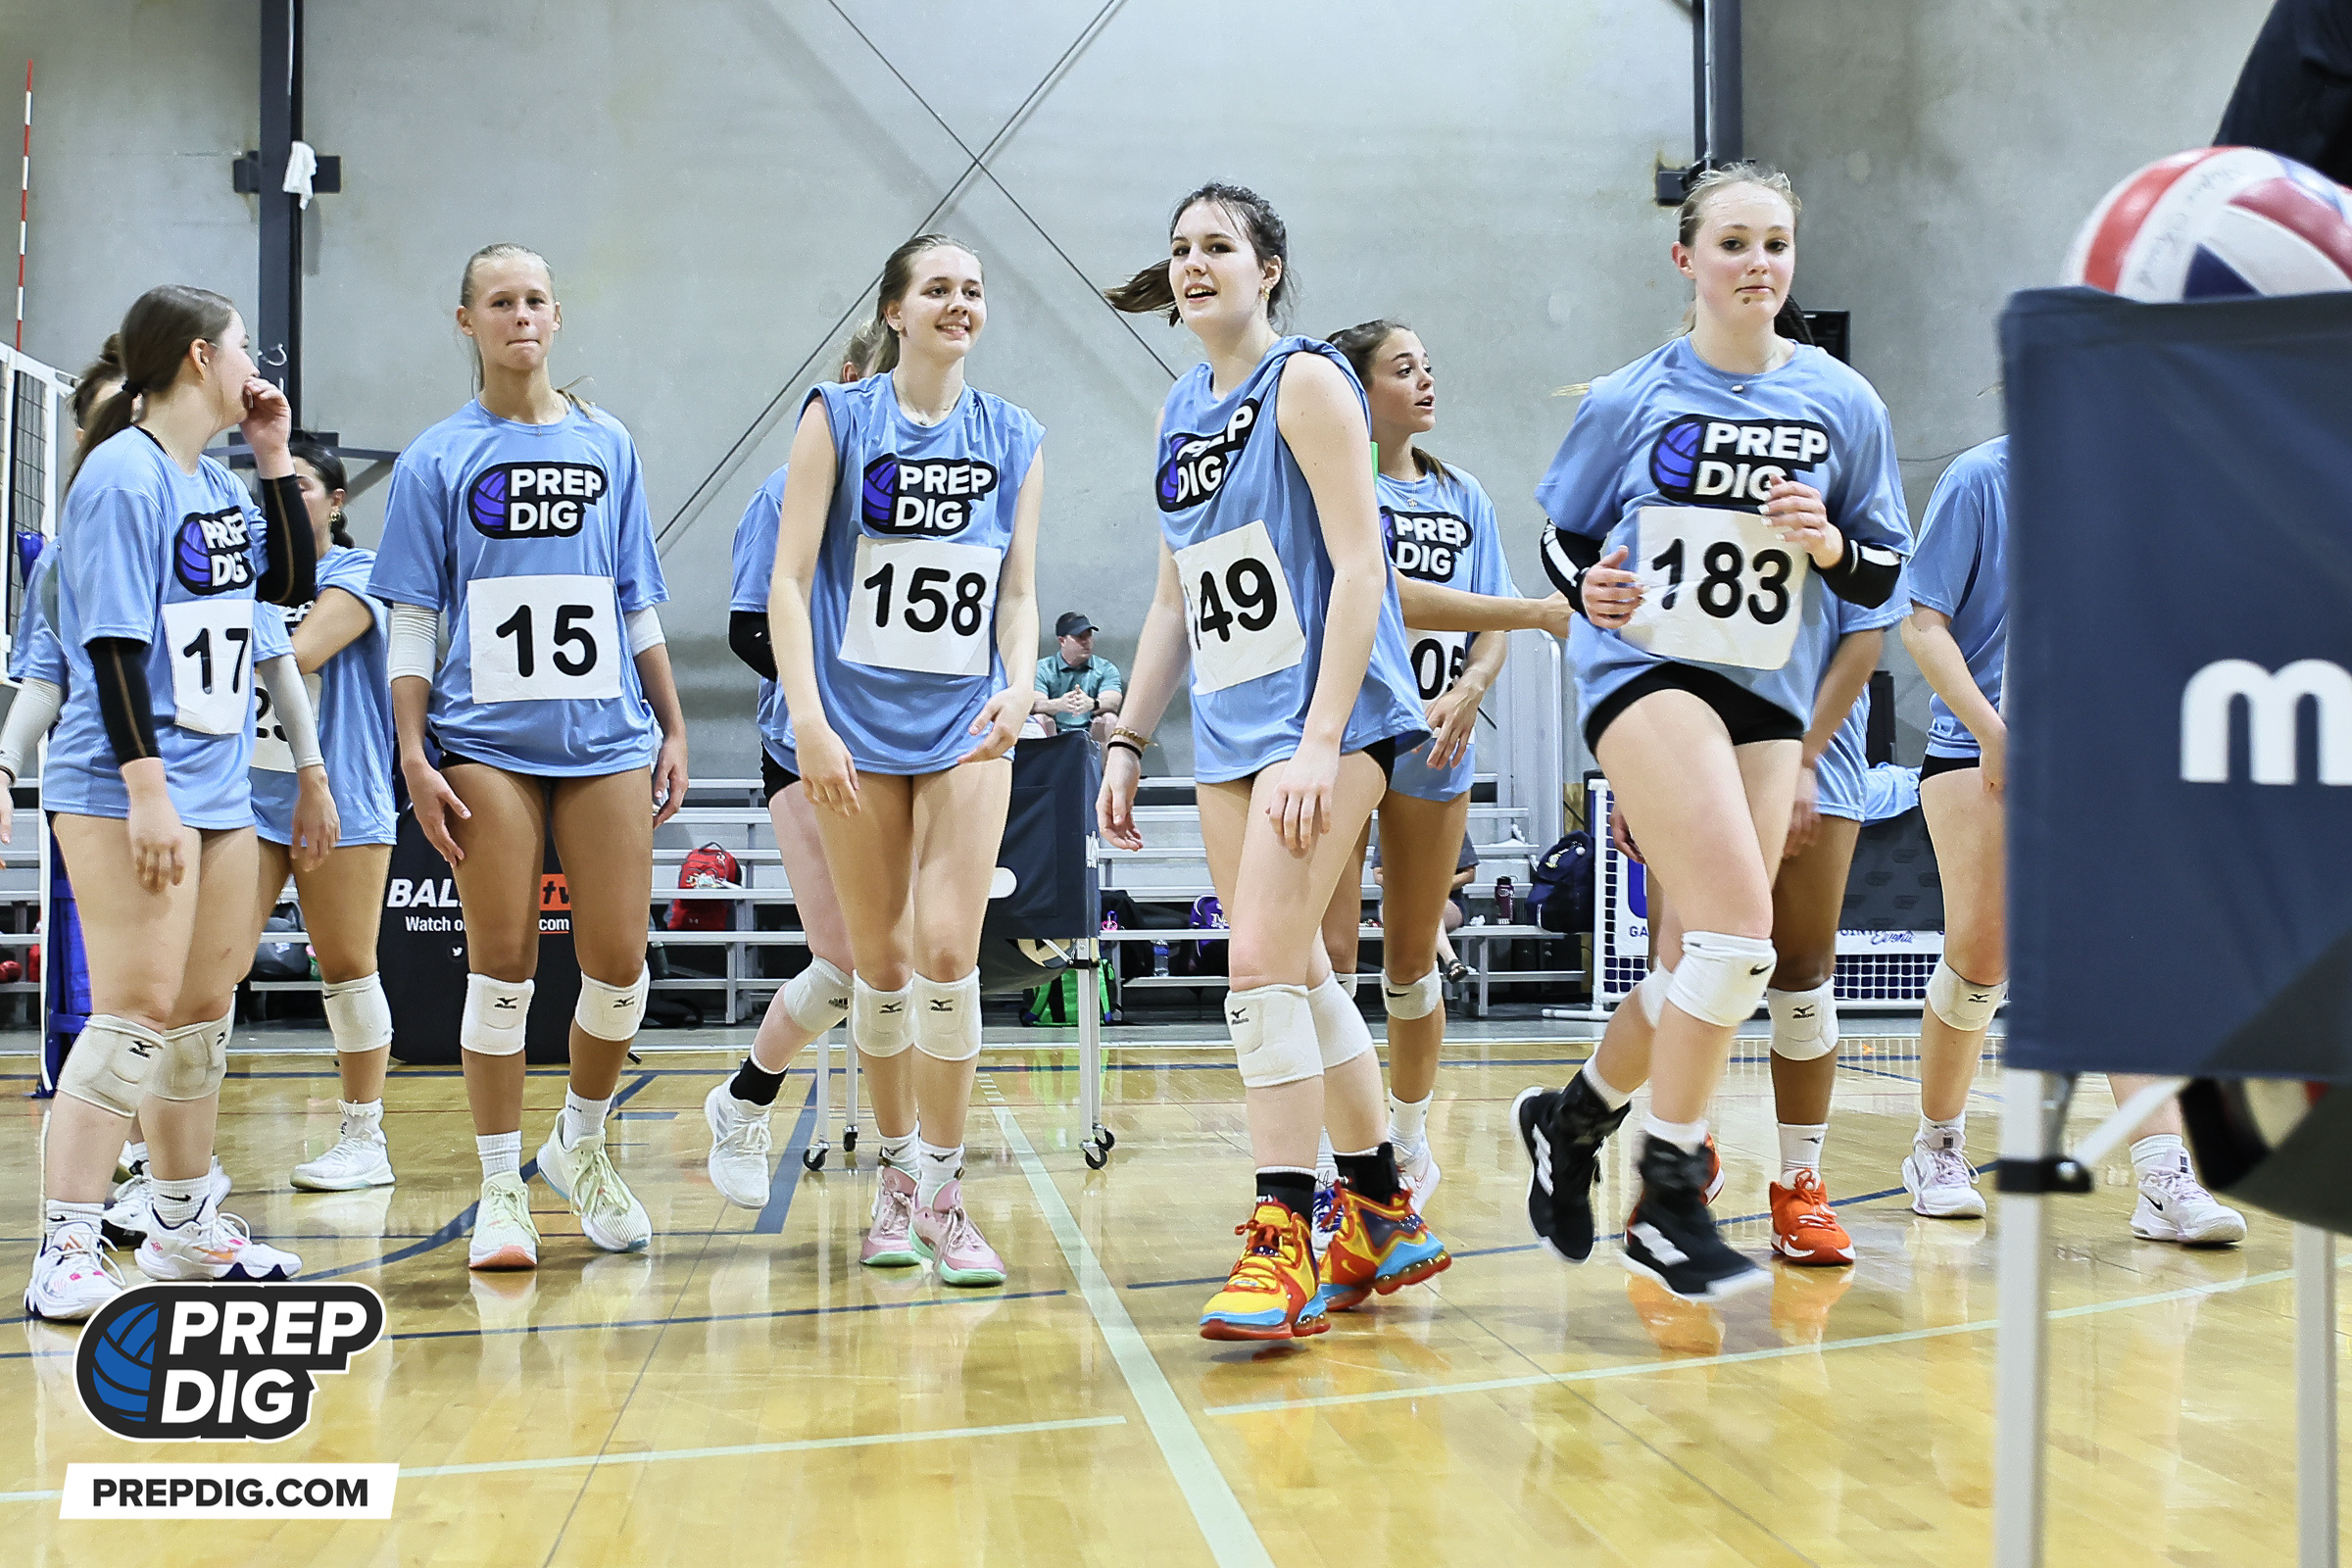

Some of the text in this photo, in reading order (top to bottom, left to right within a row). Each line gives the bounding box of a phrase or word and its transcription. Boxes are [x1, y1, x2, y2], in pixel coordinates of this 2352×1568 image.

[1701, 421, 1830, 464] PREP
[510, 467, 603, 498] PREP
[898, 464, 993, 496] PREP
[1175, 455, 1223, 503] DIG
[1692, 460, 1788, 502] DIG
[509, 500, 578, 532] DIG
[894, 496, 964, 530] DIG
[1393, 513, 1468, 547] PREP
[1396, 541, 1452, 576] DIG
[864, 563, 987, 637] 158
[1651, 538, 1793, 625] 183
[1185, 558, 1278, 651] 49
[495, 604, 598, 678] 15
[183, 627, 253, 695] 17
[386, 878, 464, 908] BAL
[405, 915, 452, 932] Watch
[454, 919, 466, 932] o
